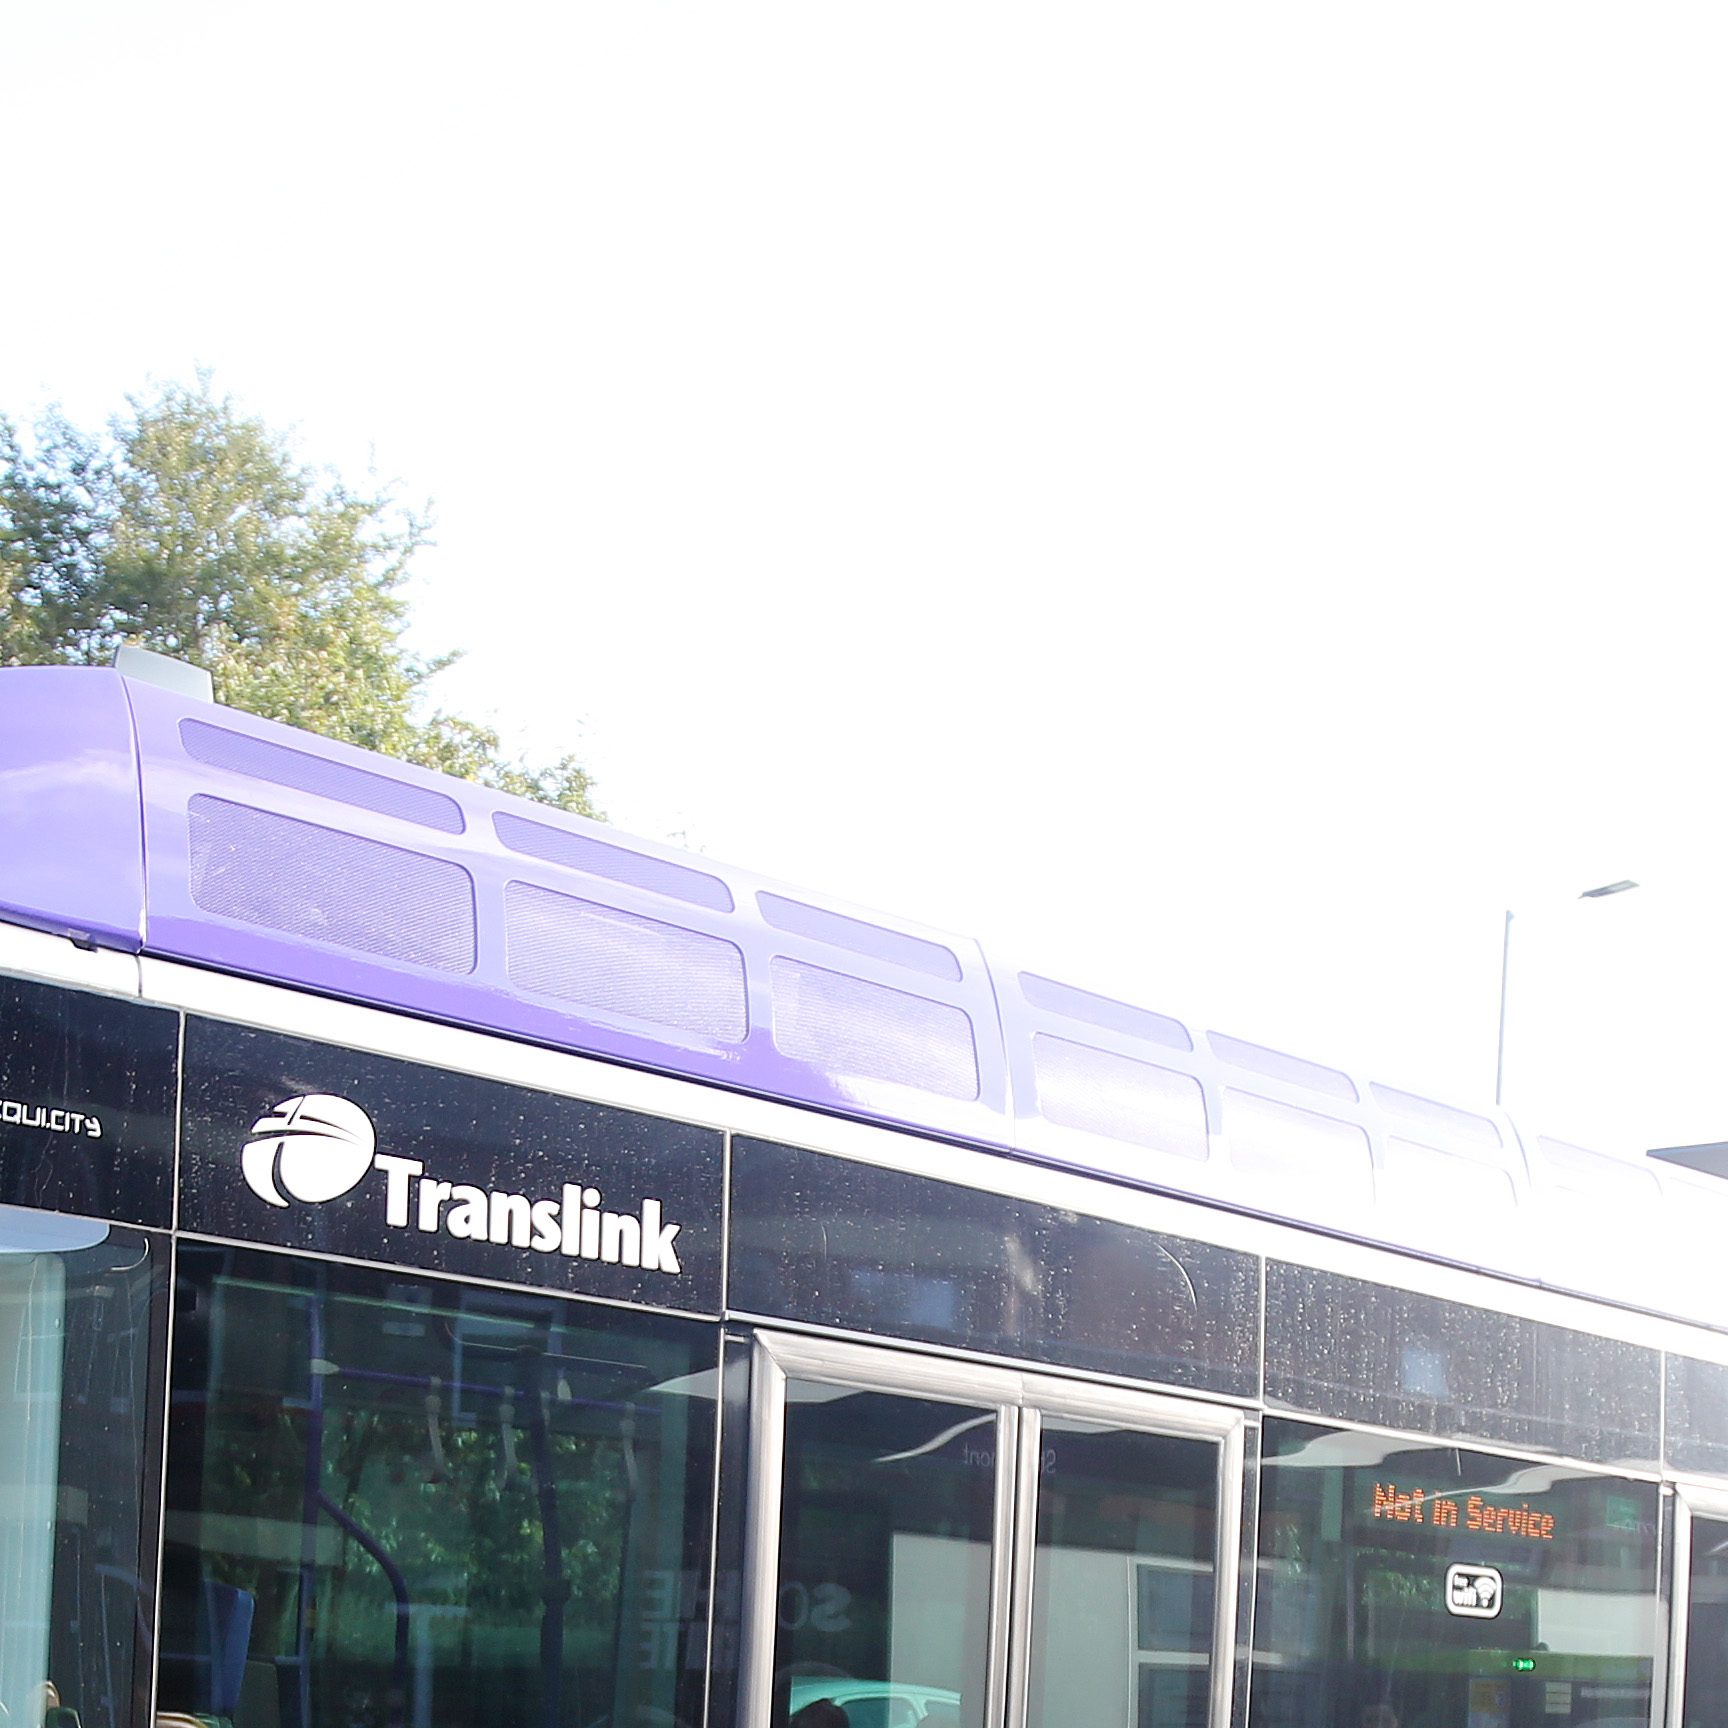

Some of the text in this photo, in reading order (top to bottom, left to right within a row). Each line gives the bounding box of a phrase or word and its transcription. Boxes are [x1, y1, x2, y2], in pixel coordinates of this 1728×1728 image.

[375, 1153, 682, 1275] Translink
[1374, 1483, 1555, 1540] Not in Service
